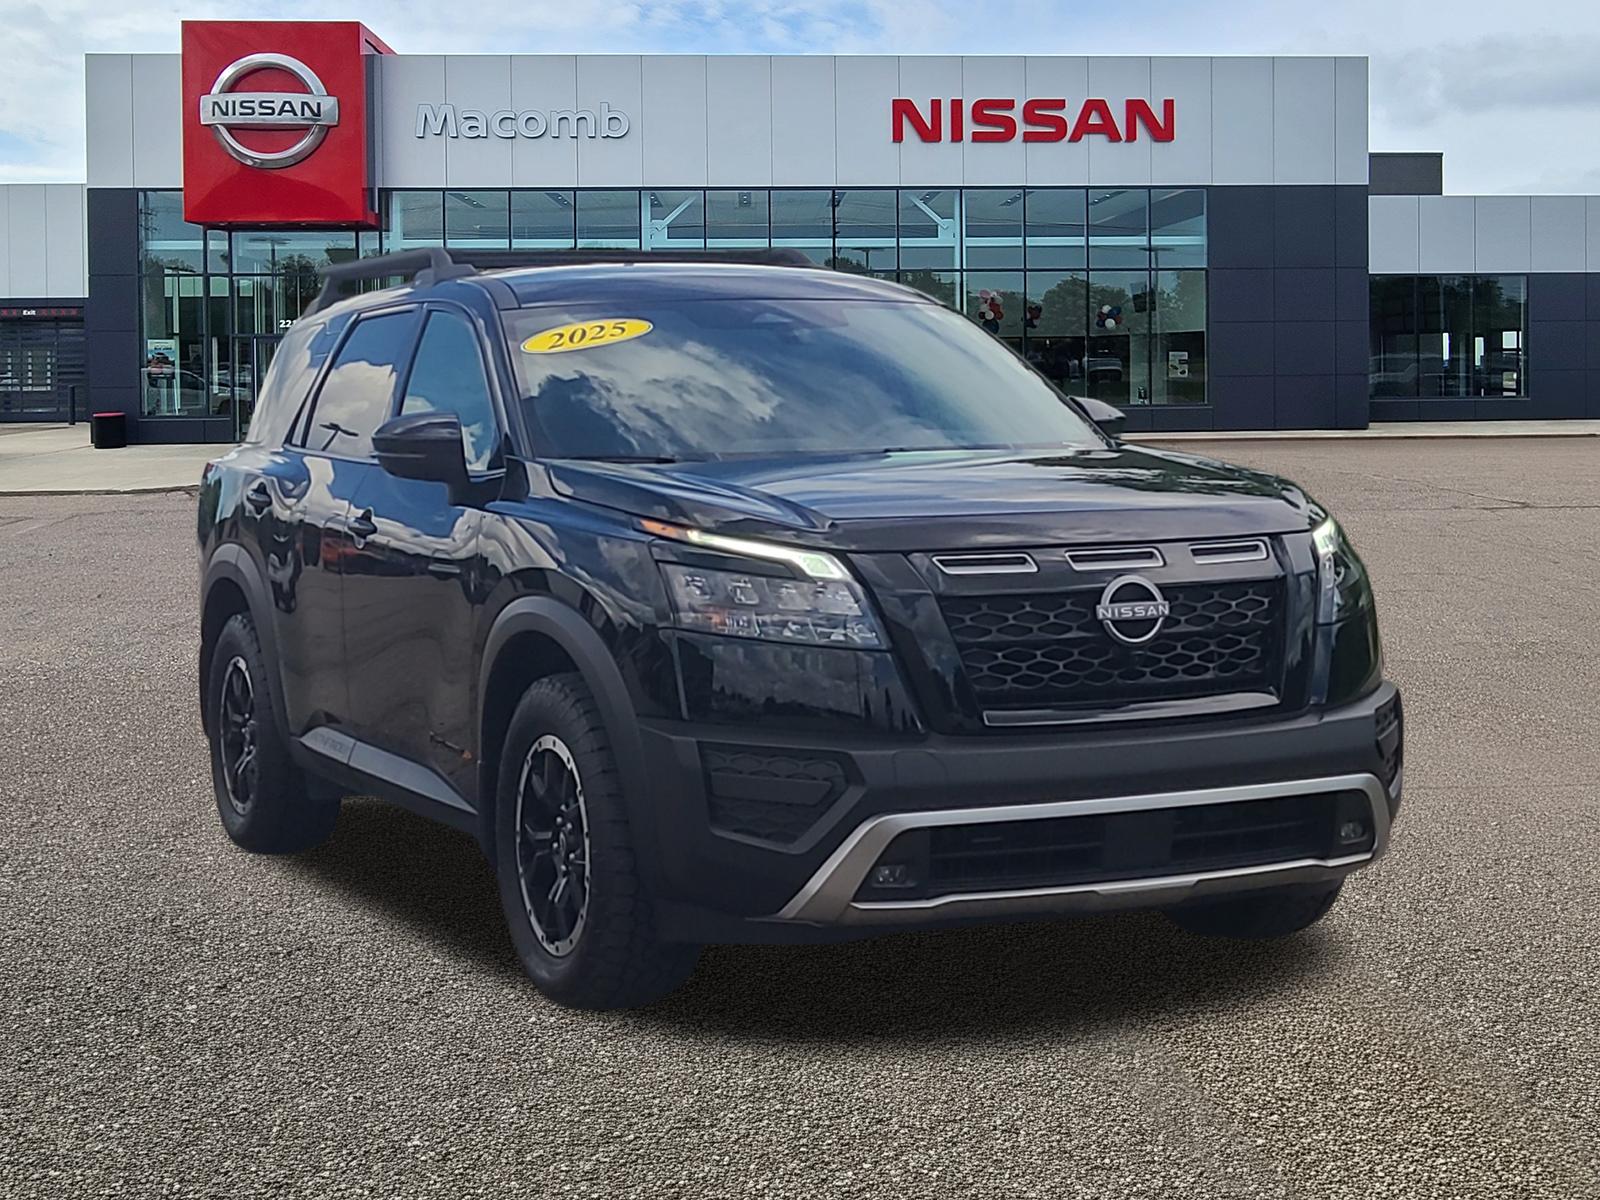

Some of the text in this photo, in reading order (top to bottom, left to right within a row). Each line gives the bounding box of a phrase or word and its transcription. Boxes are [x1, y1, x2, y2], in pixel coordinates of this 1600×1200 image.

[211, 100, 322, 118] NISSAN
[415, 102, 630, 138] Macomb
[892, 98, 1175, 143] NISSAN
[547, 321, 628, 350] 2025
[1098, 604, 1169, 619] NISSAN
